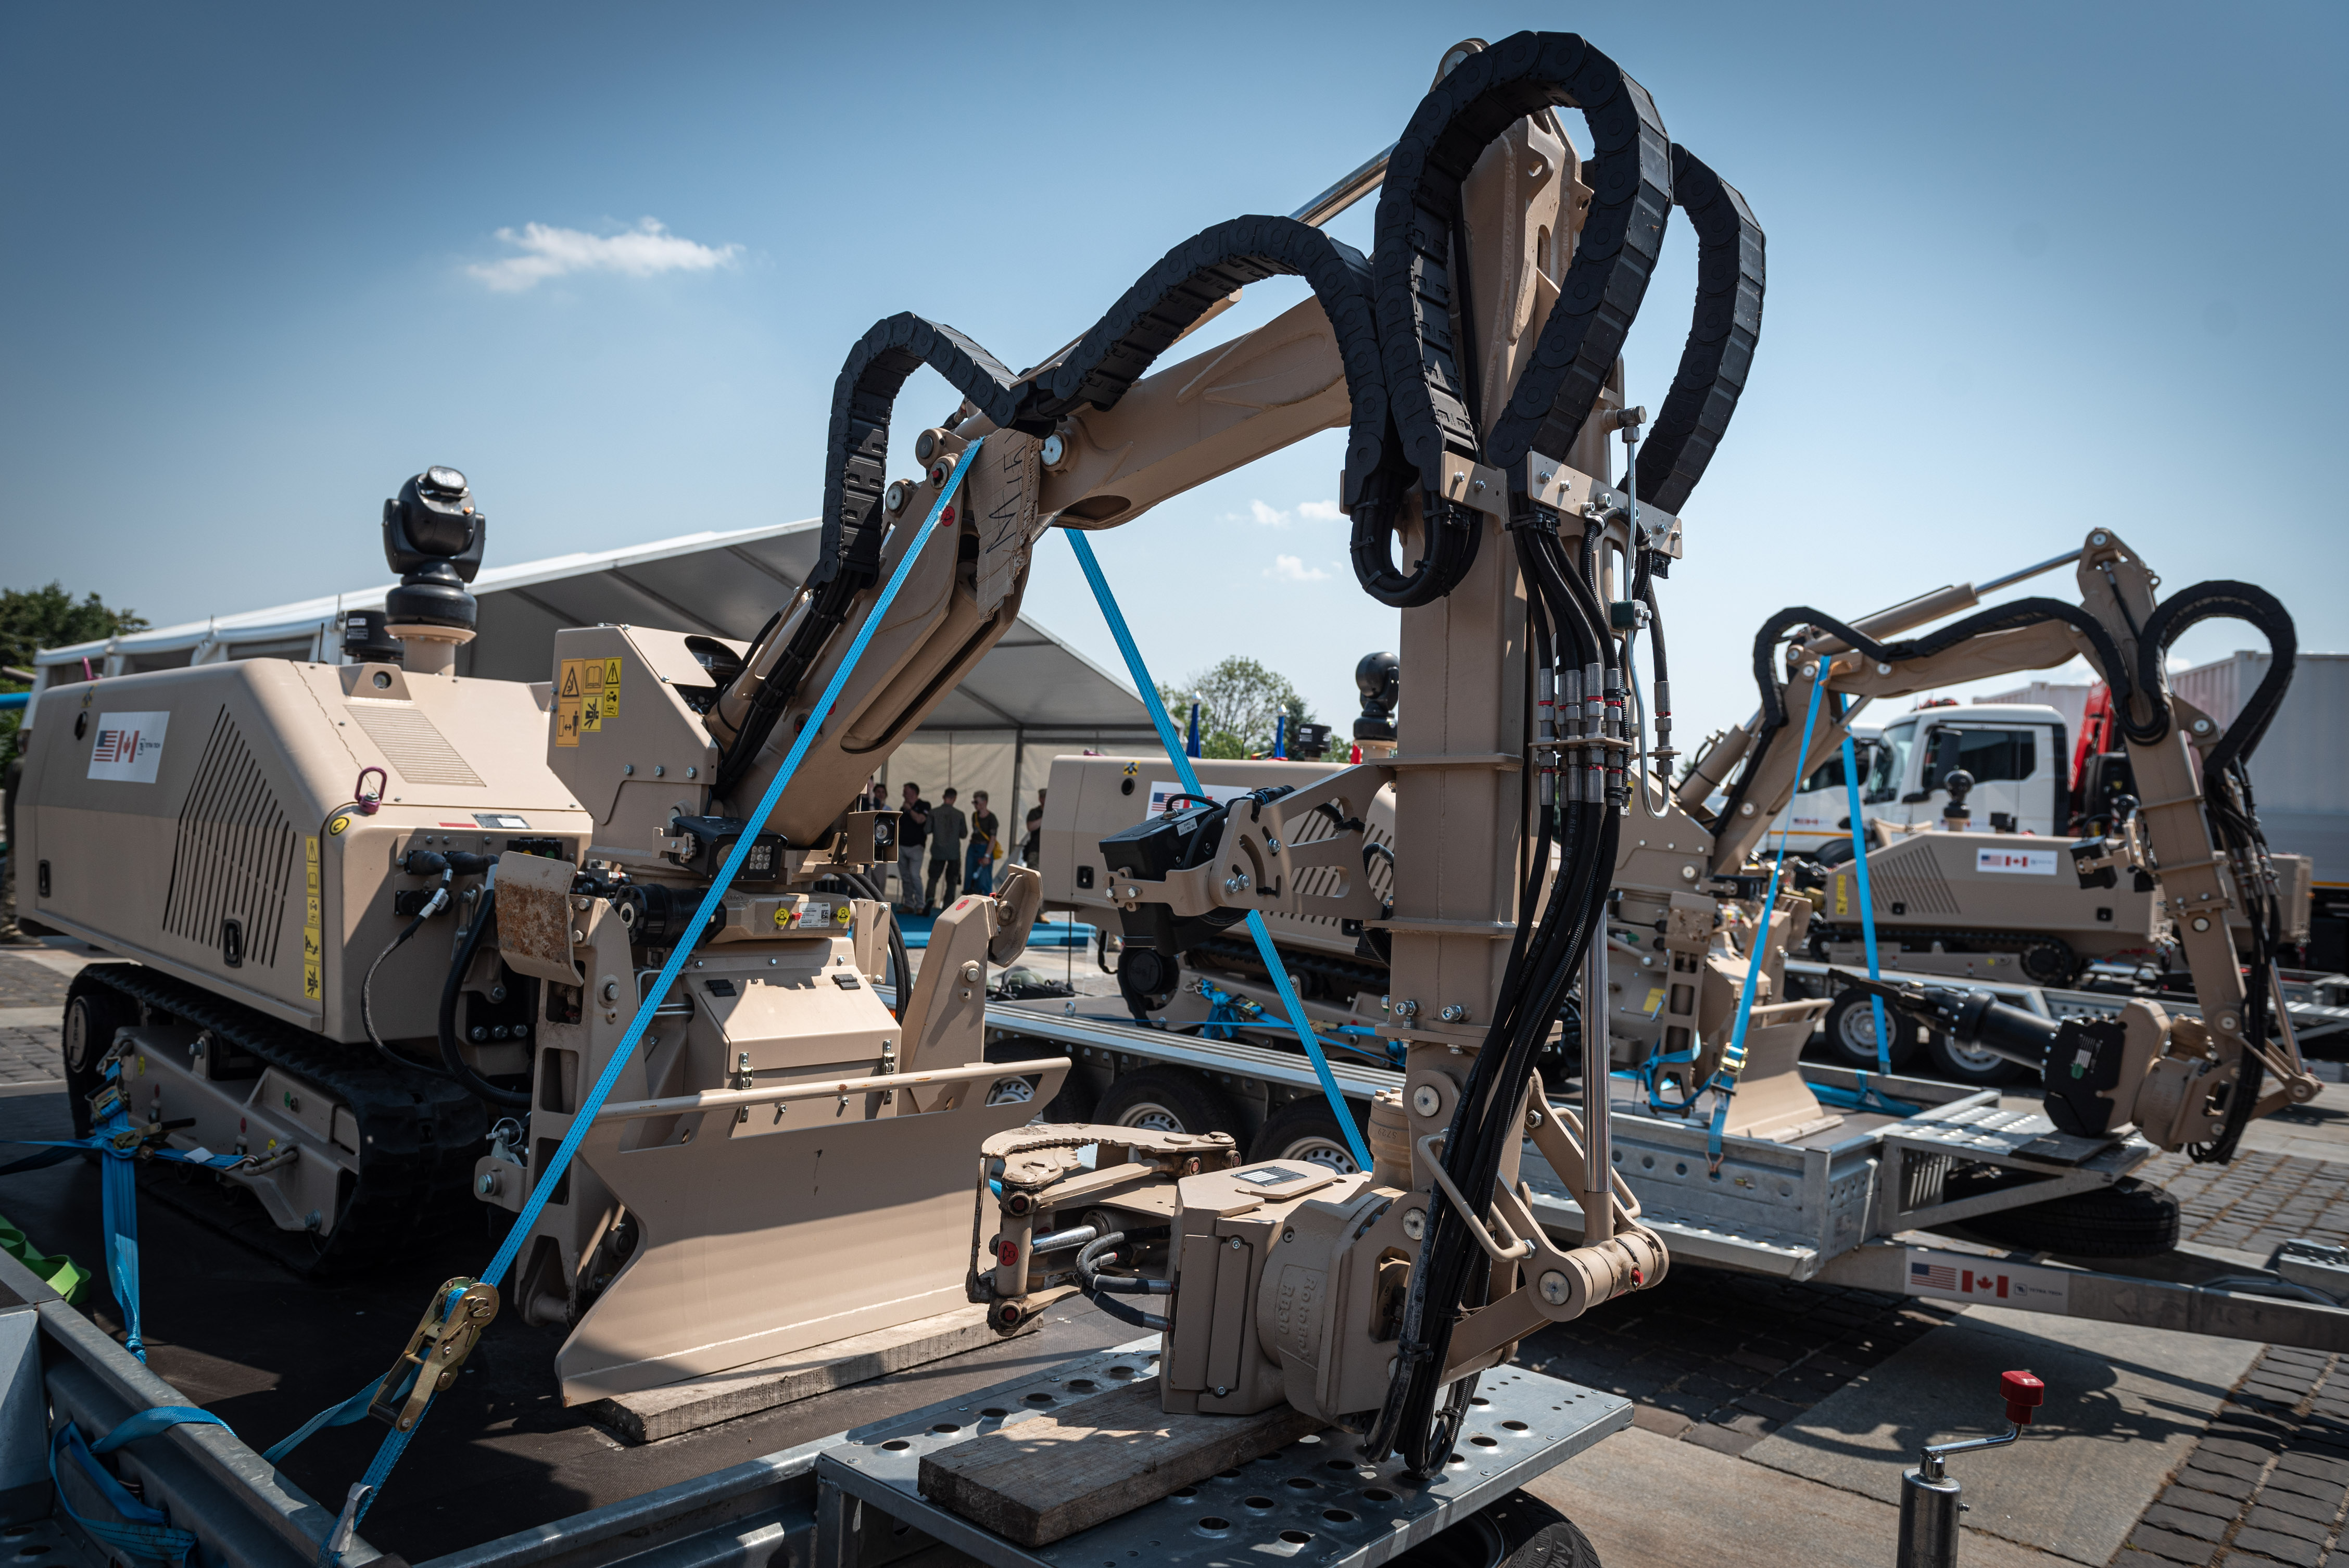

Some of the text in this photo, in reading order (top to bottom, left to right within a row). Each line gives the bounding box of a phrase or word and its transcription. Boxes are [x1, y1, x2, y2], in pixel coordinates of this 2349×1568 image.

[1565, 846, 1573, 857] EN
[1561, 860, 1570, 876] 857
[1556, 878, 1564, 893] 2SC
[1548, 905, 1556, 916] DN
[1378, 1128, 1397, 1139] 5729
[1446, 1119, 1460, 1157] FLEXOPAK
[1427, 1225, 1433, 1235] WP
[1277, 1284, 1295, 1335] RB30
